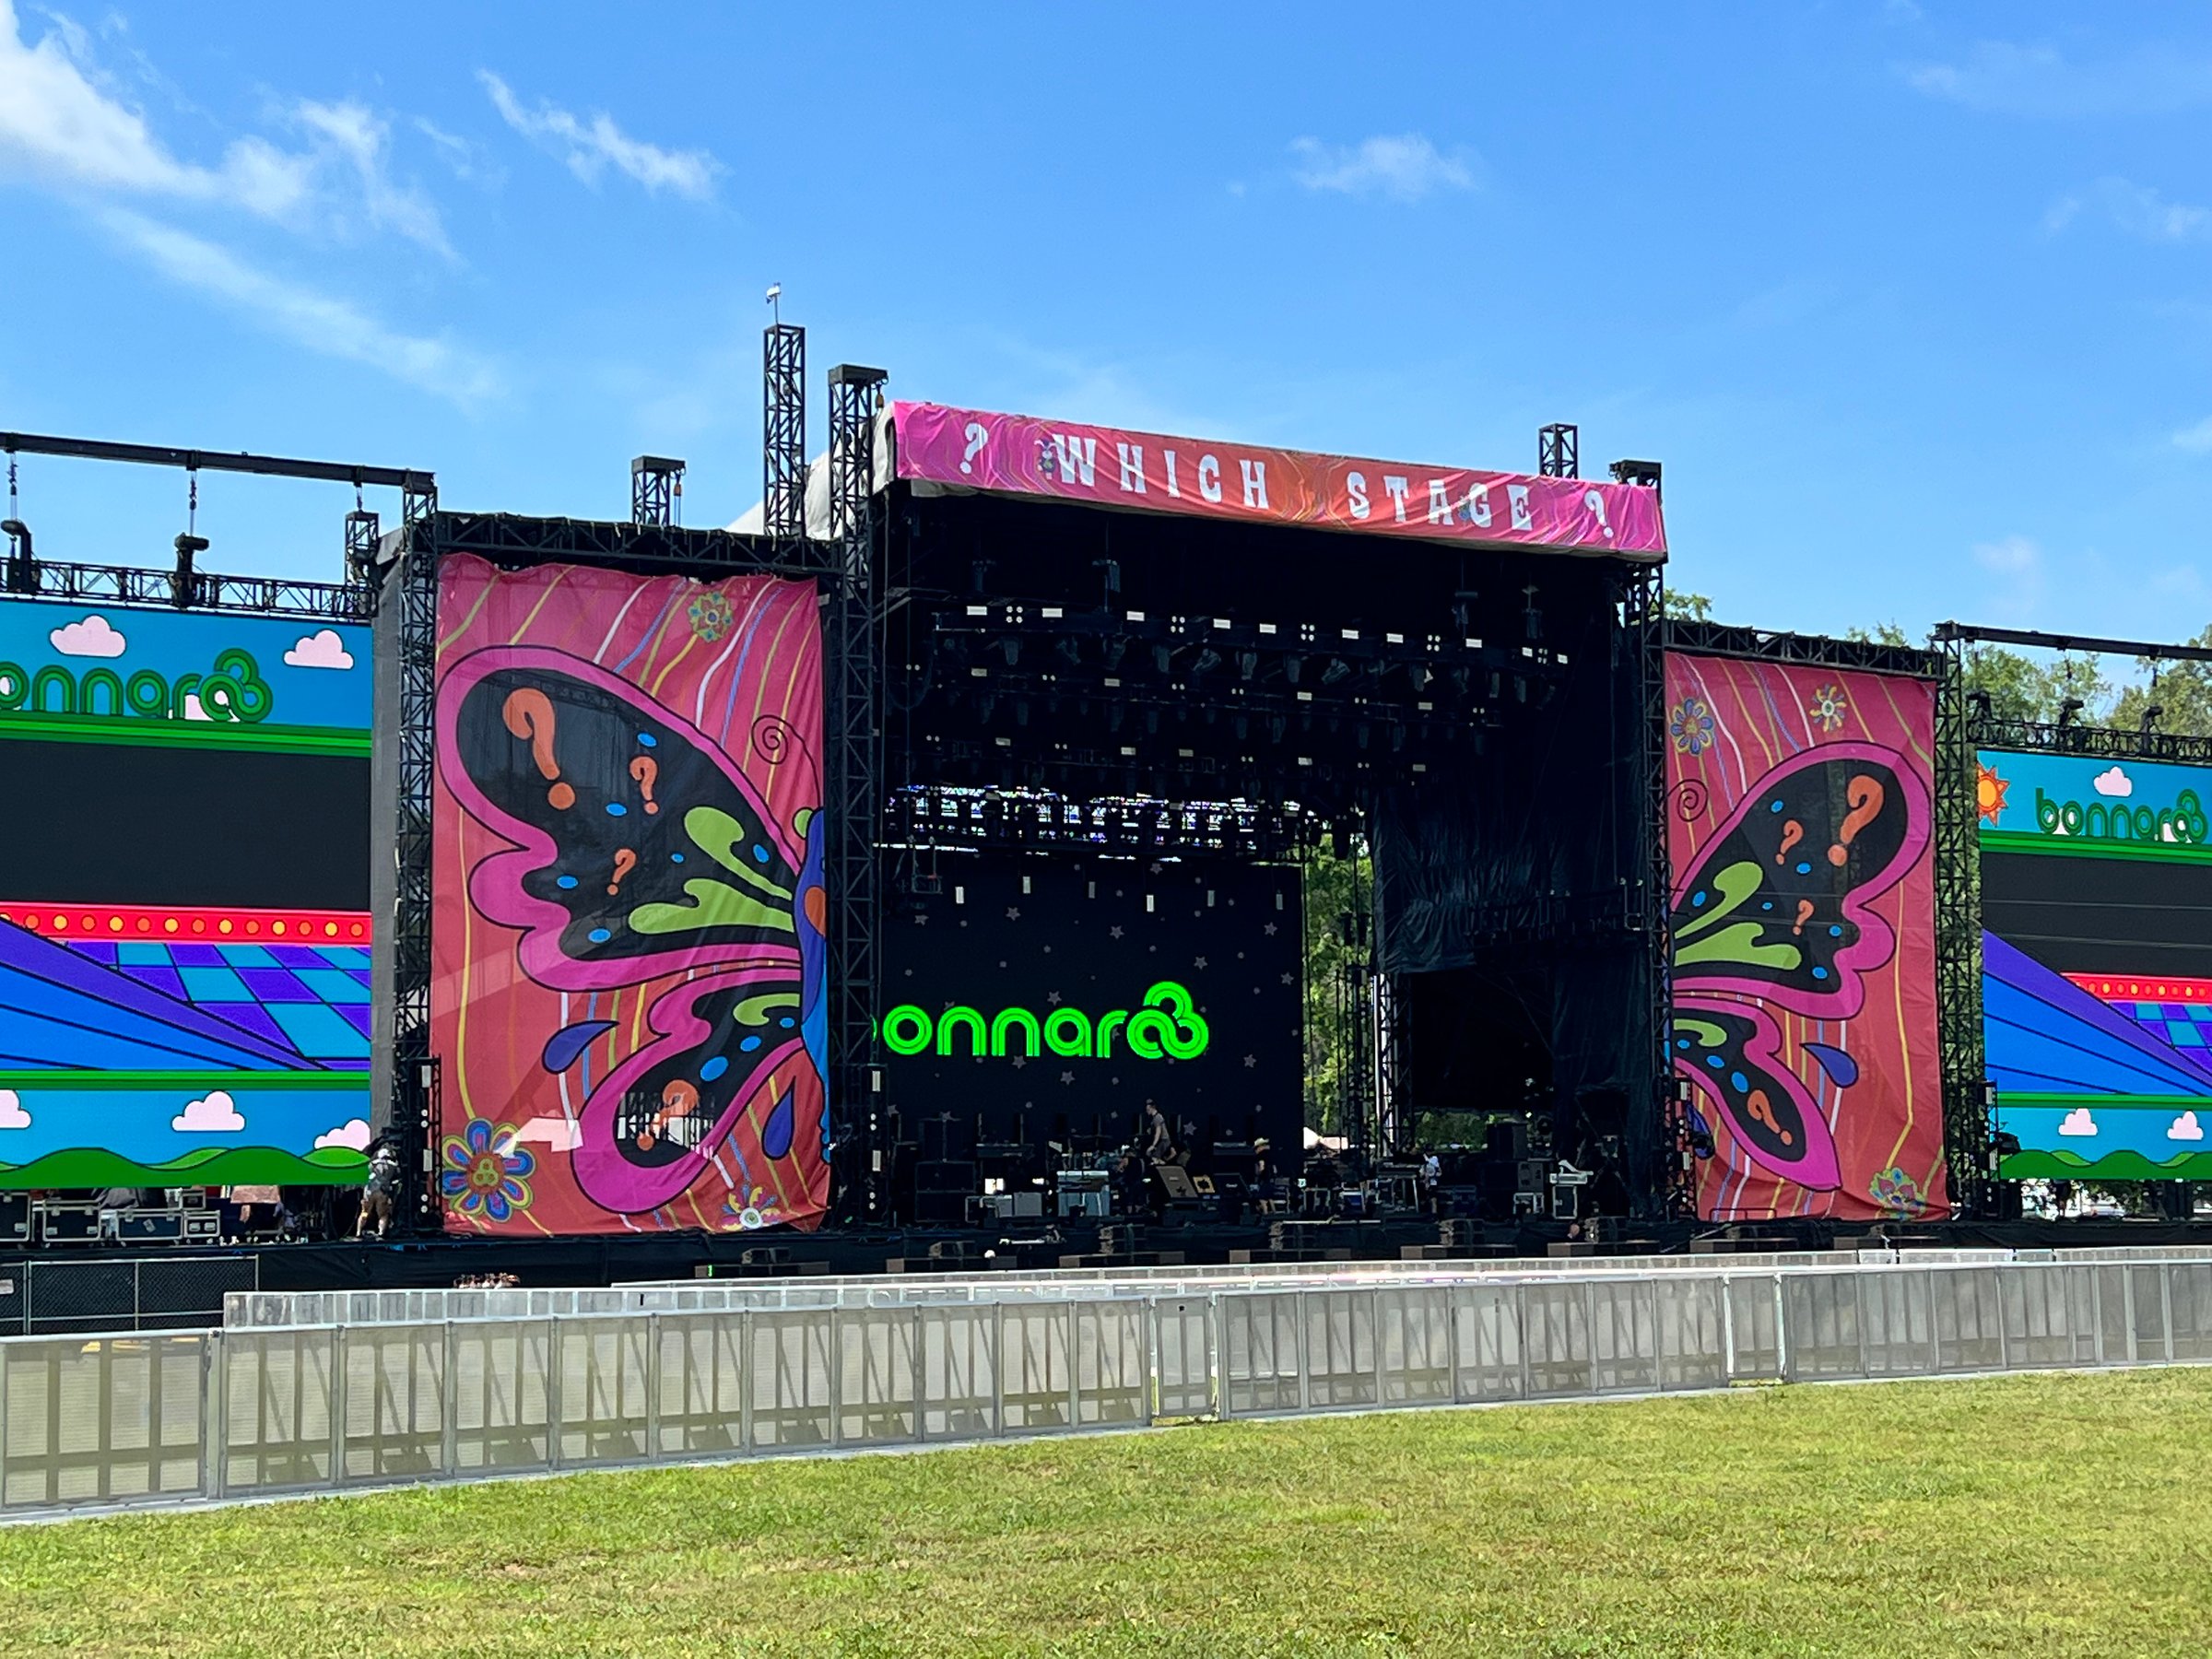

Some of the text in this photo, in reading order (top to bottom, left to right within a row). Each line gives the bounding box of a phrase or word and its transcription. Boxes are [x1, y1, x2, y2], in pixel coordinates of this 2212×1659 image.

[1052, 433, 1269, 510] WHICH
[1347, 471, 1533, 532] STAGE
[0, 648, 274, 723] onnaroo
[871, 981, 1209, 1060] onnaroo
